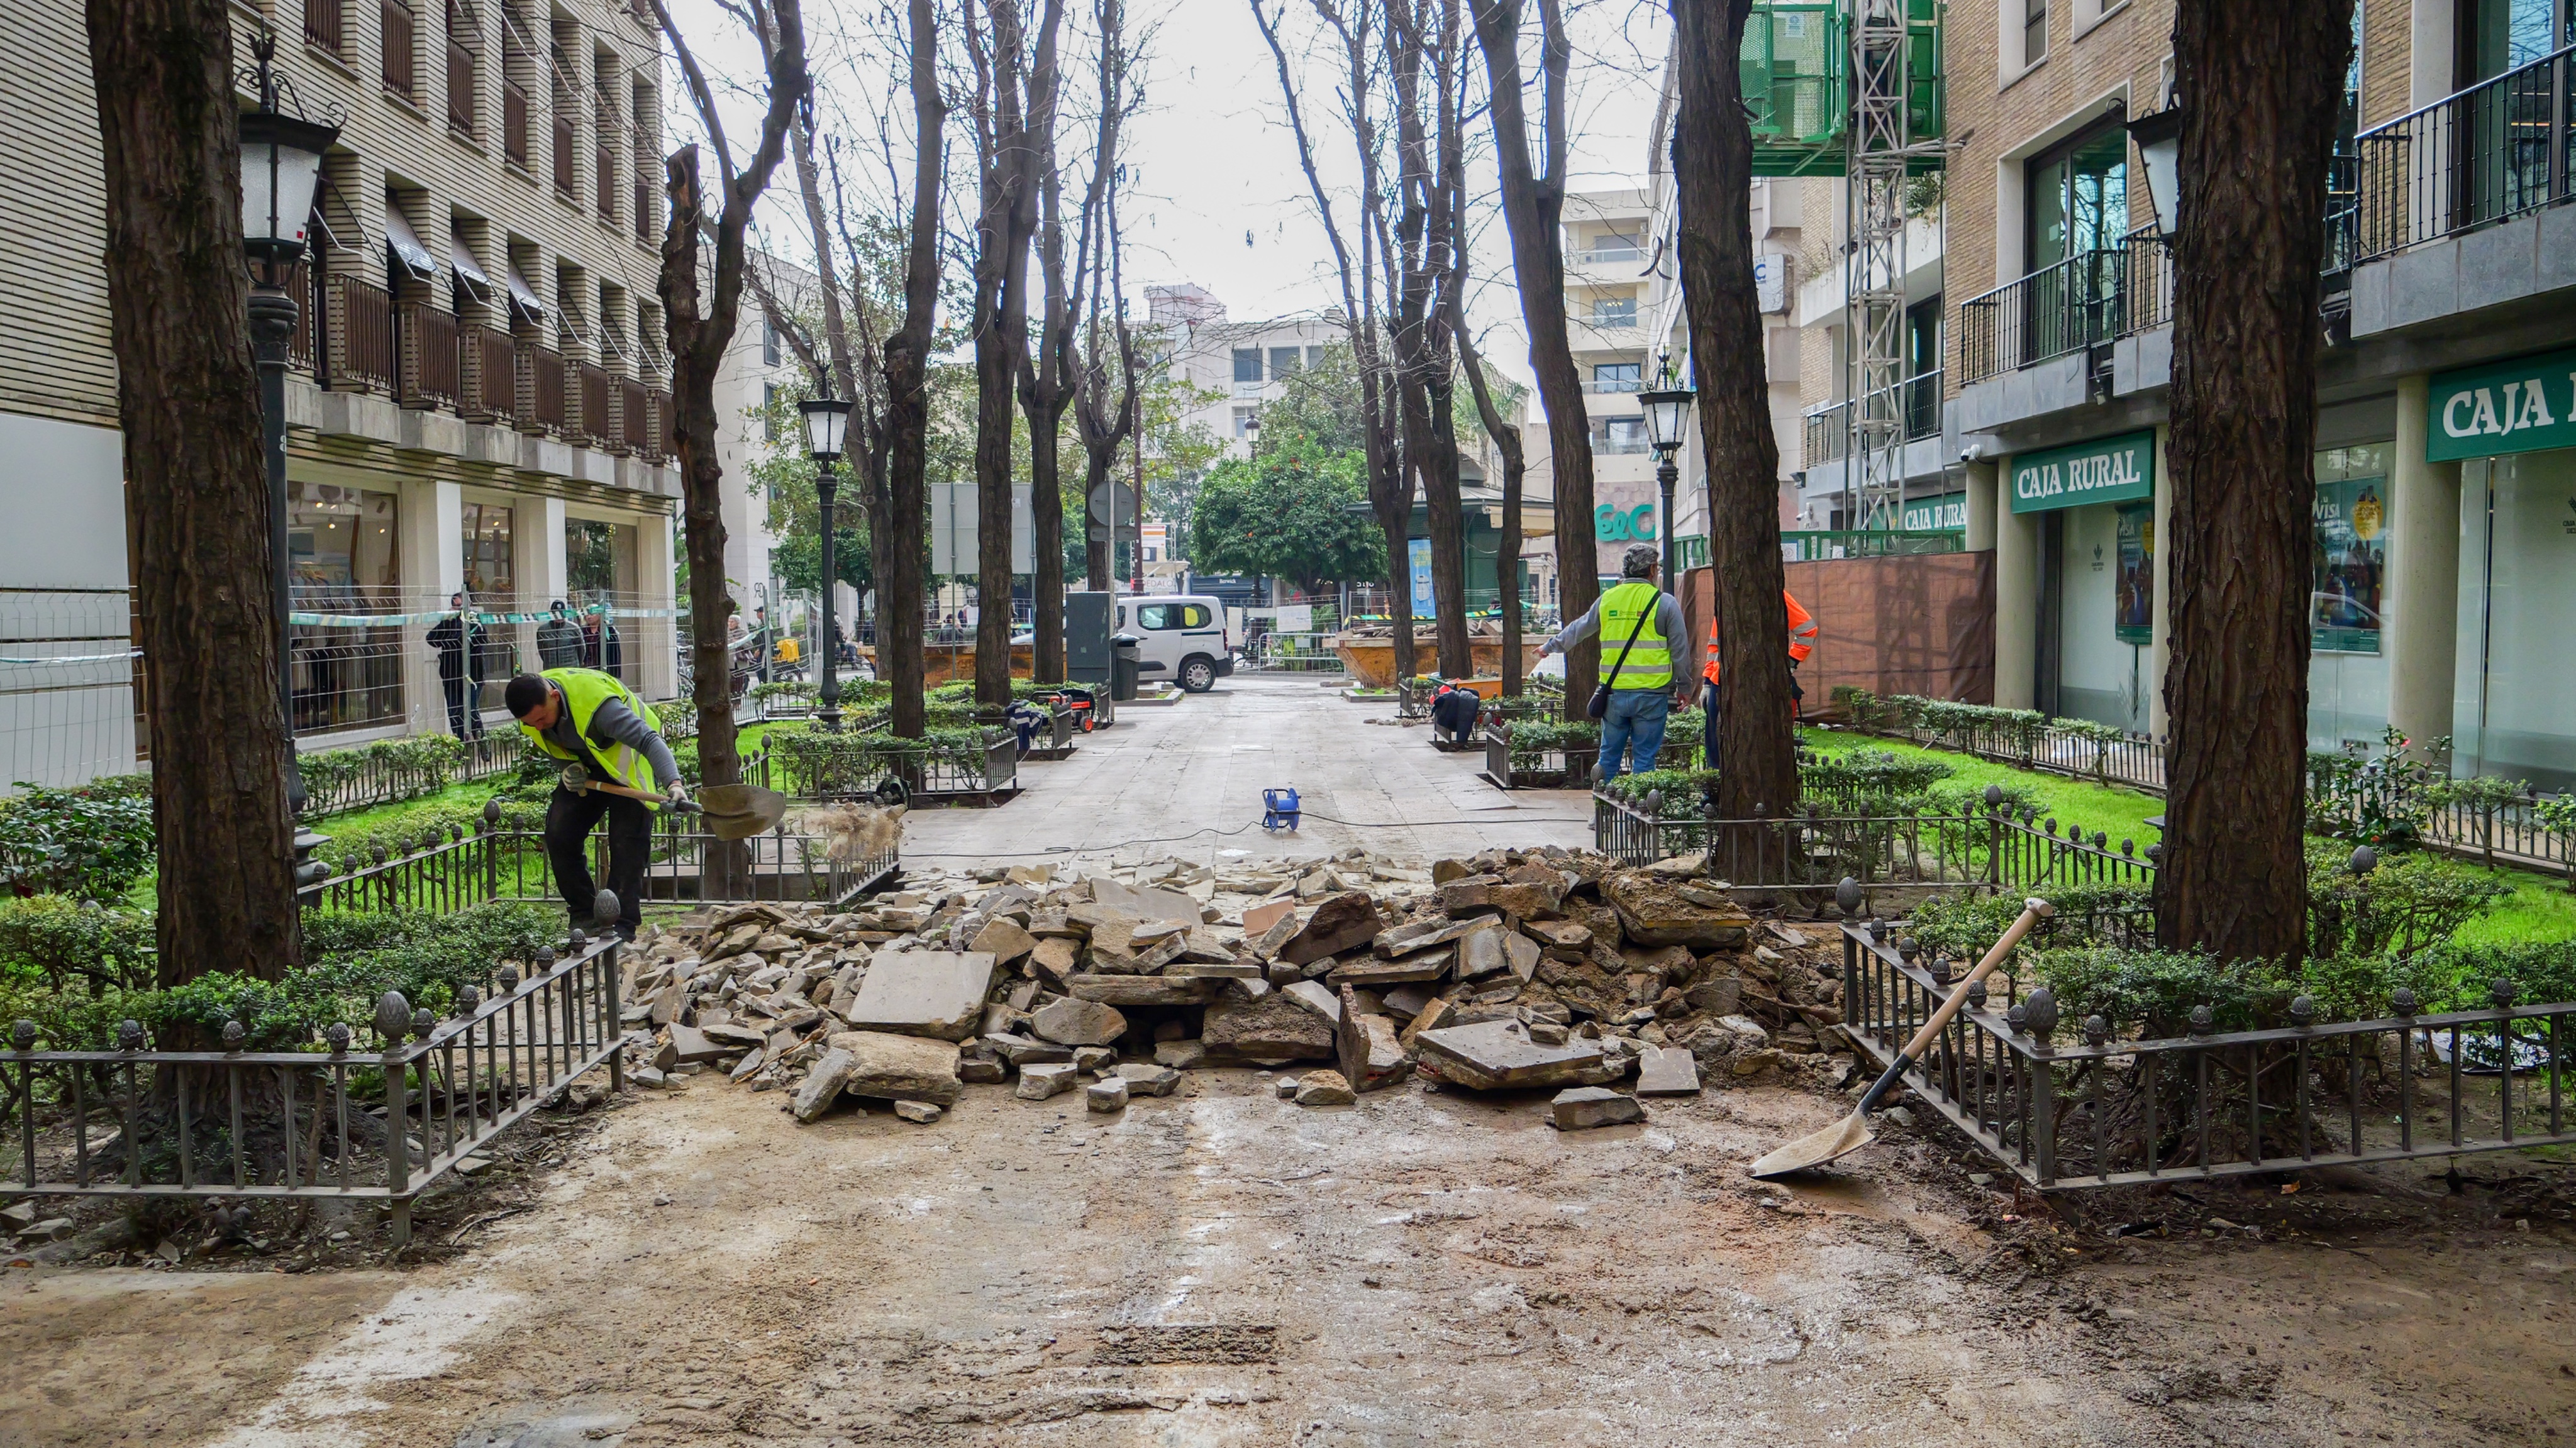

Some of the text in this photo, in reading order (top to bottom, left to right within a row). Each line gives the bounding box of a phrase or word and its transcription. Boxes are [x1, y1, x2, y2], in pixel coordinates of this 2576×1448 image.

[2443, 379, 2555, 438] CAJA
[2018, 450, 2140, 499] CAJA RURAL
[1905, 502, 1967, 531] CAJA RURA
